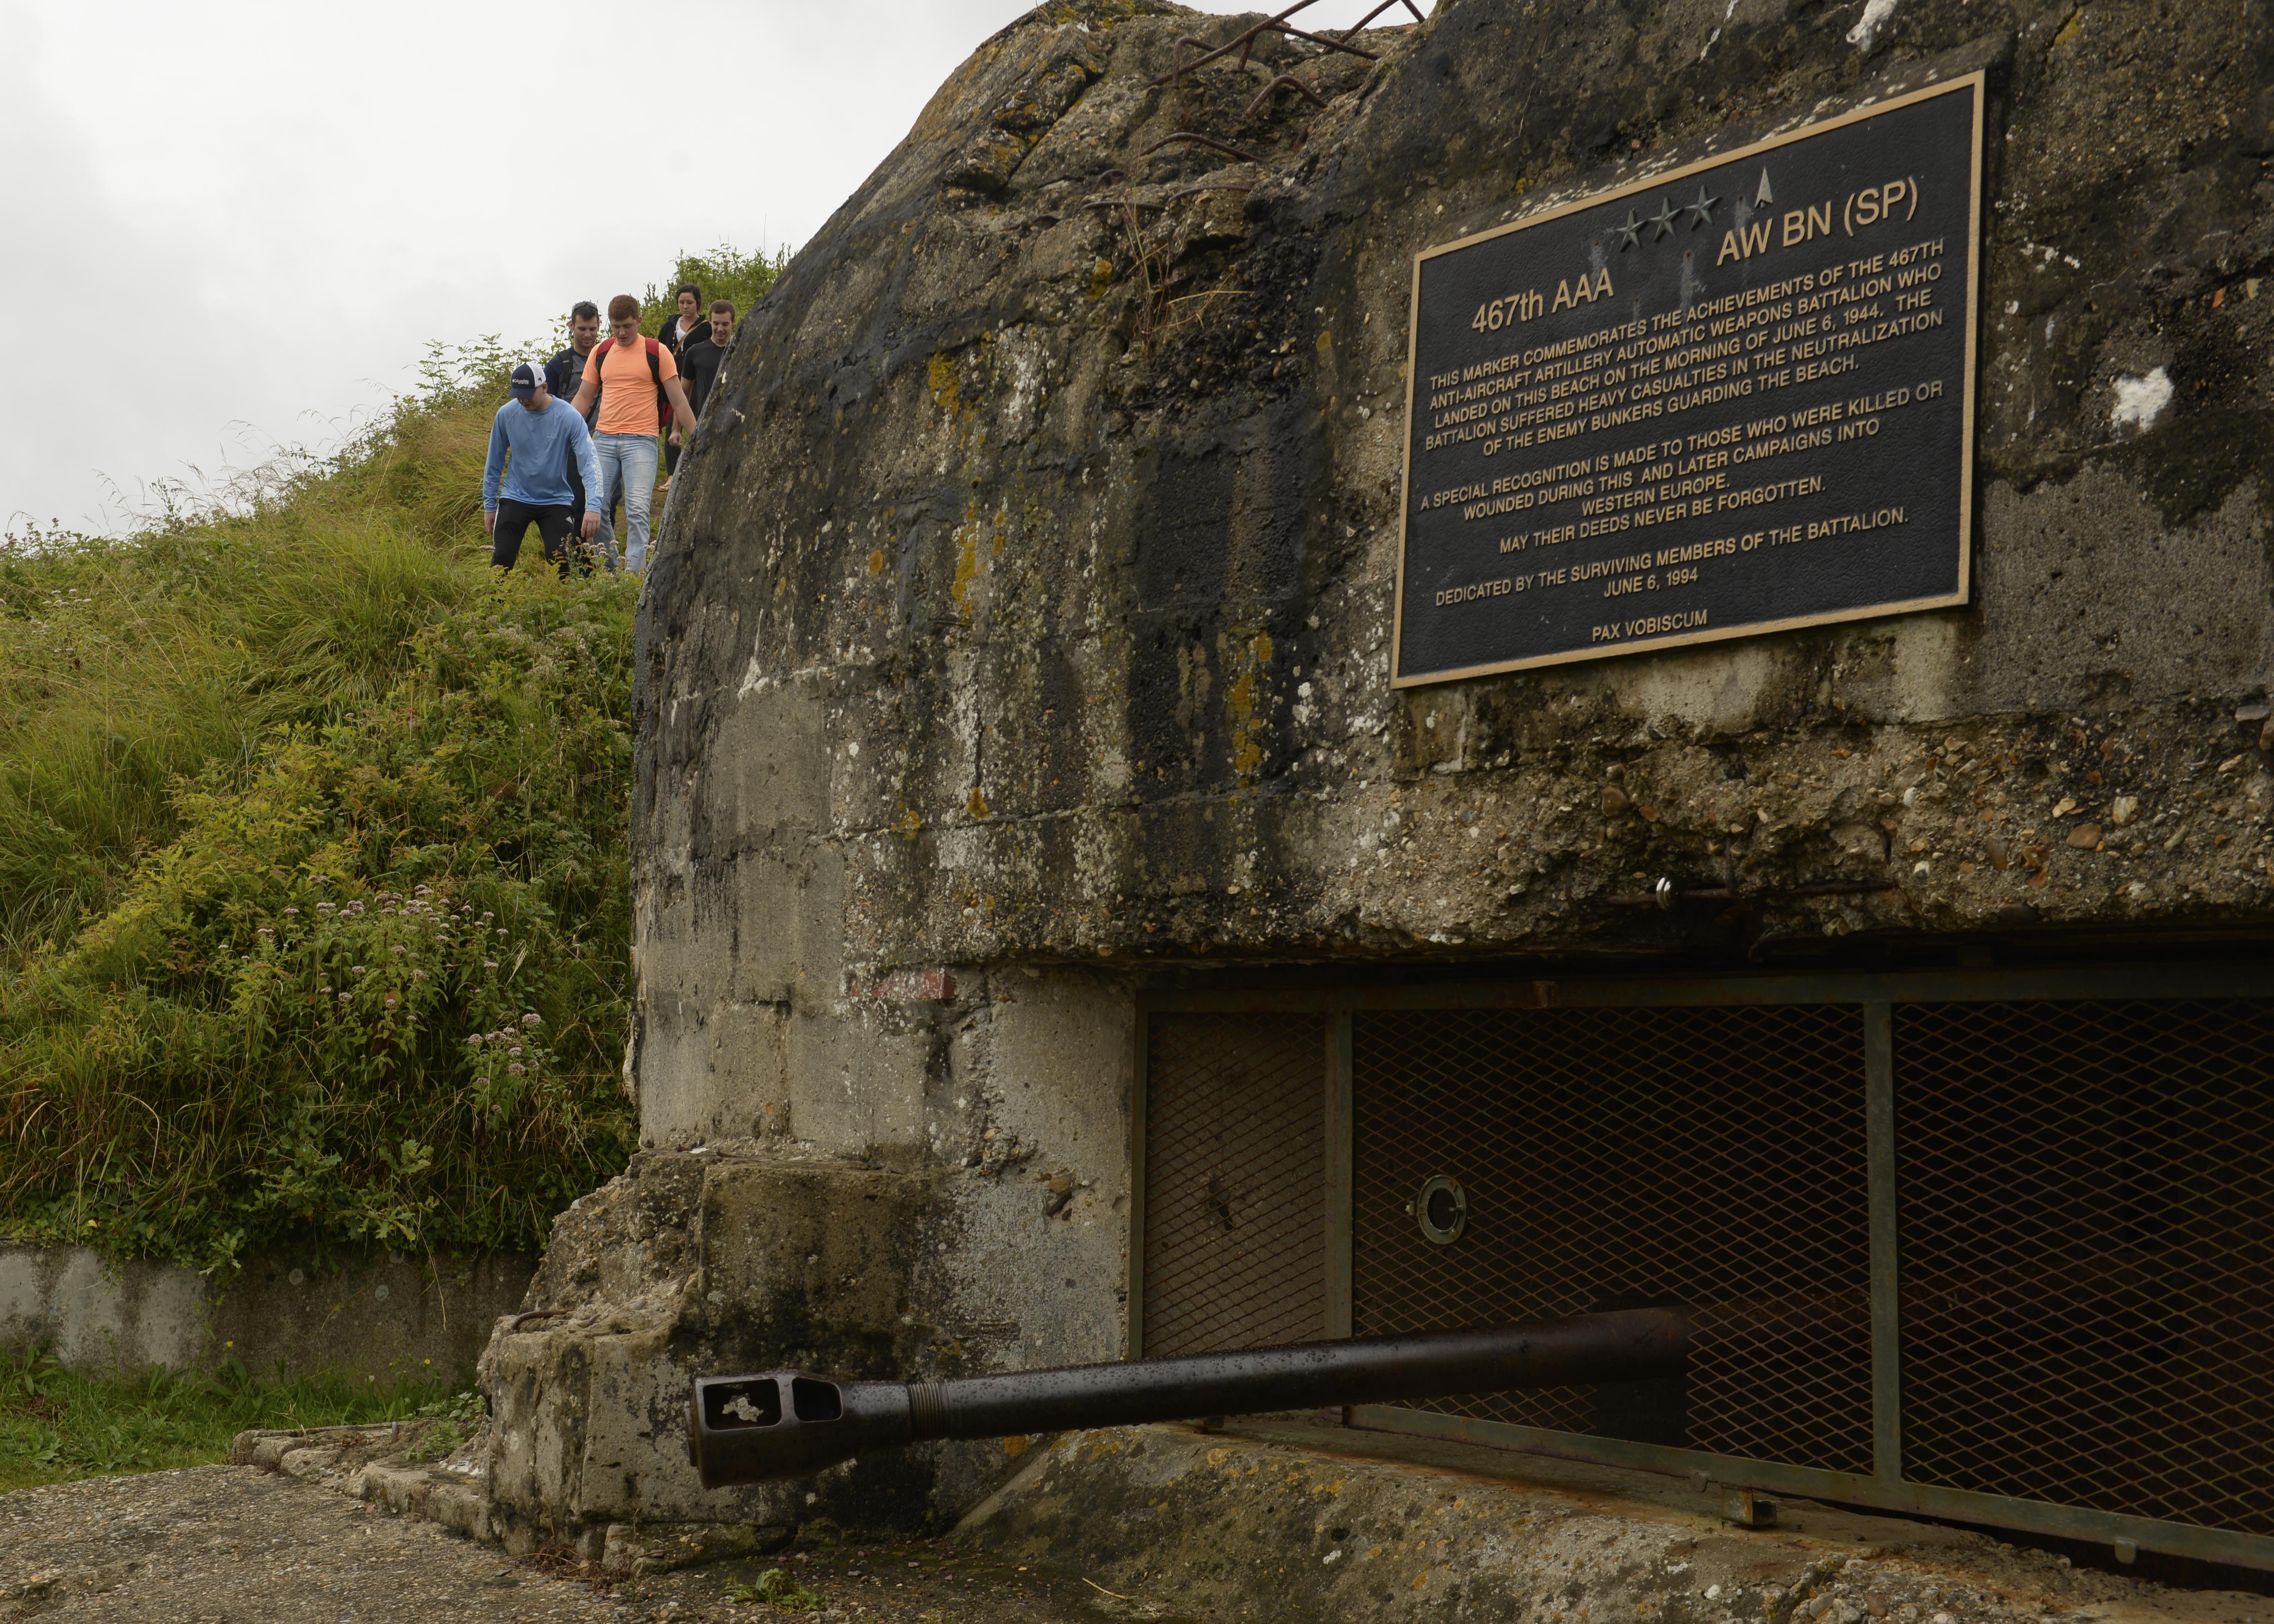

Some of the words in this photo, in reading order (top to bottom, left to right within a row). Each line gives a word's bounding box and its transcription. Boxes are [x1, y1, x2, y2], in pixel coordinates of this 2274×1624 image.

[1471, 287, 1544, 333] 467th
[1551, 267, 1615, 314] AAA
[1716, 217, 1773, 266] AW
[1781, 200, 1831, 248] BN
[1842, 177, 1918, 237] (SP)
[1429, 370, 1532, 410] ANTI-AIRCRAFT
[1534, 349, 1613, 383] ARTILLERY
[1616, 324, 1706, 362] AUTOMATIC
[1709, 301, 1793, 337] WEAPONS
[1796, 275, 1892, 315] BATTALION
[1896, 262, 1941, 289] WHO
[1430, 369, 1460, 390] THIS
[1462, 353, 1520, 382] MARKER
[1522, 318, 1647, 366] COMMEMORATES
[1651, 309, 1682, 332] THE
[1686, 274, 1814, 322] ACHIEVEMENTS
[1818, 265, 1844, 287] OF
[1847, 254, 1884, 279] THE
[1887, 239, 1943, 267] 467TH
[1434, 401, 1489, 429] LANDED
[1490, 396, 1512, 414] ON
[1514, 387, 1548, 407] THIS
[1550, 374, 1600, 400] BEACH
[1603, 365, 1627, 386] ON
[1630, 357, 1661, 379] THE
[1663, 336, 1741, 371] MORNING
[1745, 329, 1769, 350] OF
[1771, 317, 1817, 344] JUNE
[1820, 314, 1836, 331] 6,
[1843, 302, 1883, 325] 1944.
[1894, 288, 1931, 311] THE
[1425, 420, 1496, 450] BATTALION
[1499, 400, 1575, 433] SUFFERED
[1577, 387, 1628, 414] HEAVY
[1630, 361, 1728, 400] CASUALTIES
[1731, 358, 1748, 376] IN
[1753, 347, 1786, 370] THE
[1790, 310, 1942, 361] NEUTRALIZATION
[1483, 437, 1502, 456] OF
[1505, 430, 1534, 450] THE
[1536, 418, 1588, 444] ENEMY
[1591, 400, 1663, 431] BUNKERS
[1666, 378, 1753, 413] GUARDING
[1757, 369, 1790, 391] THE
[1795, 354, 1858, 383] BEACH.
[1420, 496, 1430, 509] A
[1433, 483, 1489, 508] SPECIAL
[1491, 459, 1591, 495] RECOGNITION
[1594, 454, 1610, 472] IS
[1613, 443, 1657, 468] MADE
[1660, 438, 1683, 457] TO
[1686, 424, 1742, 451] THOSE
[1746, 415, 1788, 439] WHO
[1791, 402, 1843, 429] WERE
[1847, 388, 1909, 417] KILLED
[1915, 381, 1942, 401] OR
[1463, 491, 1535, 520] WOUNDED
[1538, 478, 1594, 505] DURING
[1598, 470, 1633, 492] THIS
[1640, 461, 1674, 484] AND
[1677, 450, 1729, 476] LATER
[1731, 428, 1831, 464] CAMPAIGNS
[1837, 418, 1879, 442] INTO
[1581, 486, 1656, 517] WESTERN
[1659, 472, 1730, 501] EUROPE.
[1435, 578, 1512, 606] DEDICATED
[1514, 575, 1534, 592] BY
[1538, 568, 1566, 587] THE
[1569, 553, 1652, 582] SURVIVING
[1656, 536, 1736, 567] MEMBERS
[1740, 531, 1765, 551] OF
[1768, 525, 1802, 546] THE
[1807, 507, 1909, 540] BATTALION.
[1499, 535, 1529, 554] MAY
[1532, 524, 1576, 546] THEIR
[1579, 513, 1630, 538] DEEDS
[1634, 502, 1688, 526] NEVER
[1690, 497, 1713, 516] BE
[1717, 475, 1827, 512] FORGOTTEN.
[1591, 623, 1621, 642] PAX
[1624, 608, 1708, 637] VOBISCUM
[1603, 575, 1644, 597] JUNE
[1646, 573, 1660, 590] 6,
[1665, 567, 1699, 586] 1994
